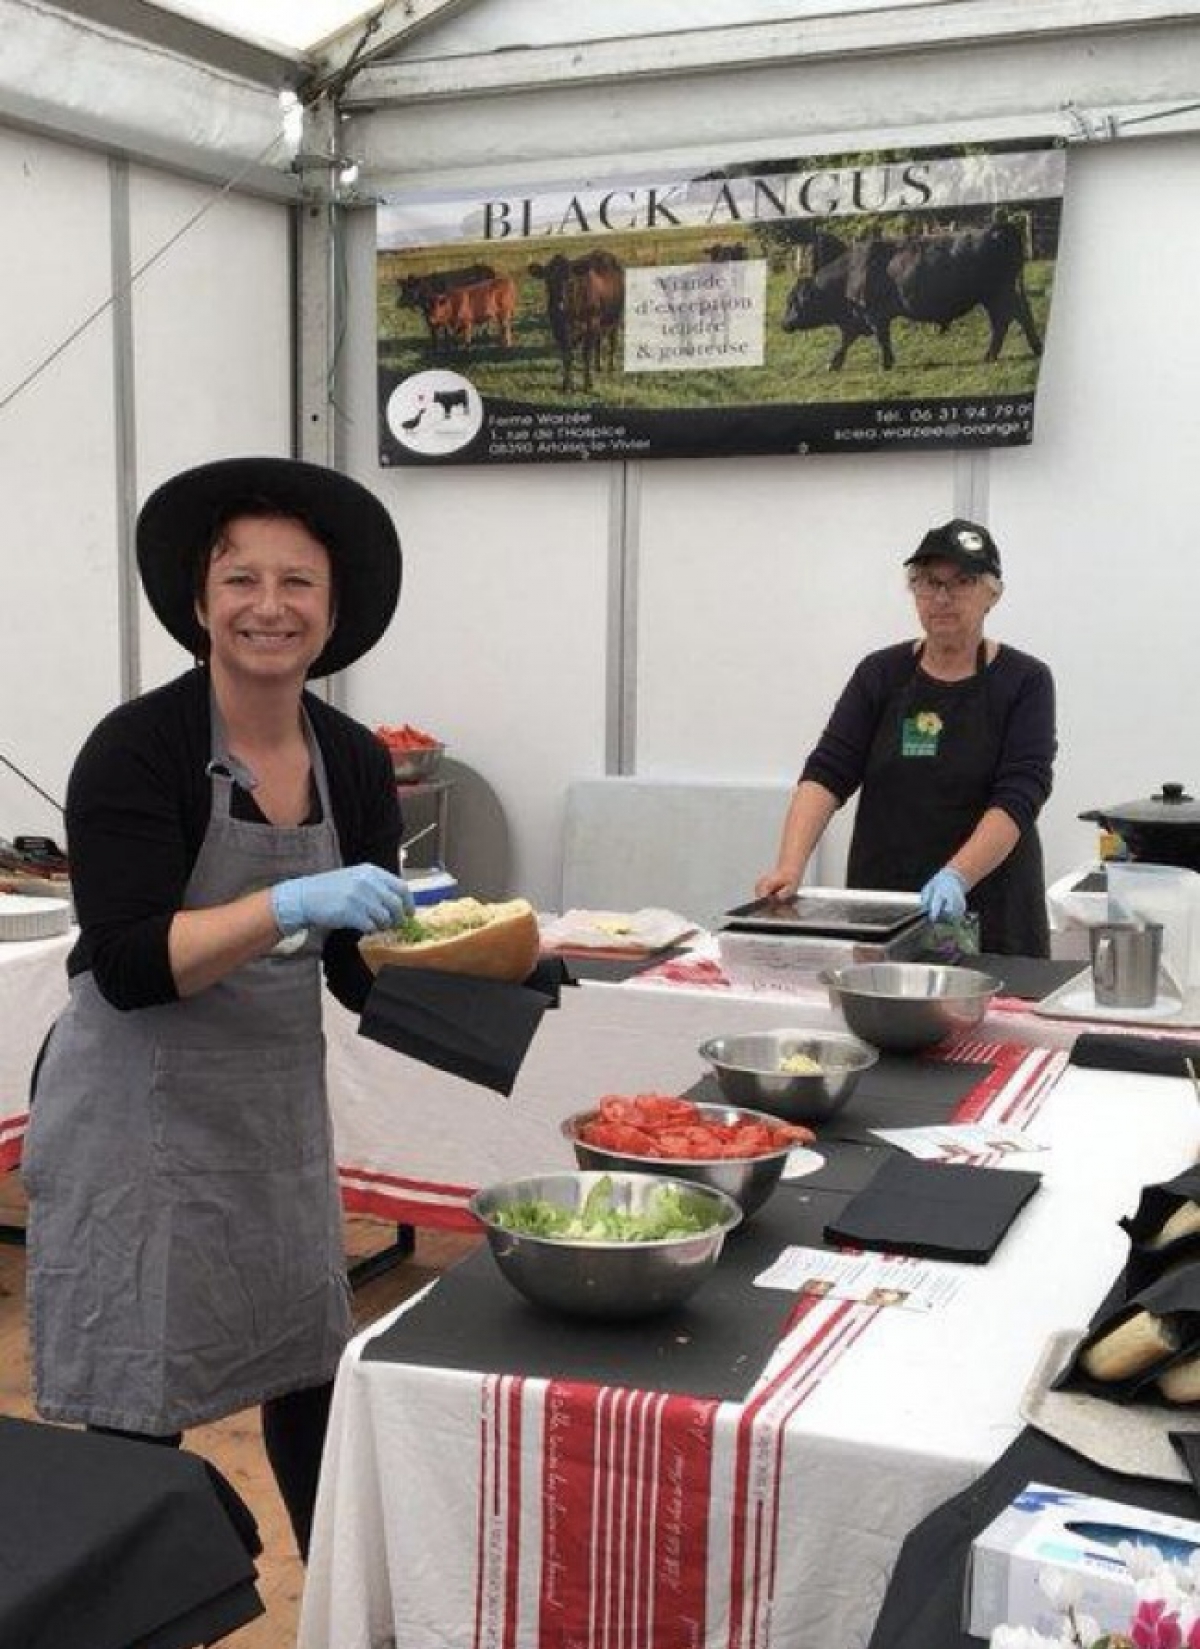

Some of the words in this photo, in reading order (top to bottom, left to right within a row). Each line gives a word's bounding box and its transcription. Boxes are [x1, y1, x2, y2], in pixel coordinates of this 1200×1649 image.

[483, 188, 682, 240] BLACK
[707, 164, 934, 223] ANGUS
[909, 407, 933, 422] 06
[939, 406, 959, 420] 31
[533, 427, 552, 440] de
